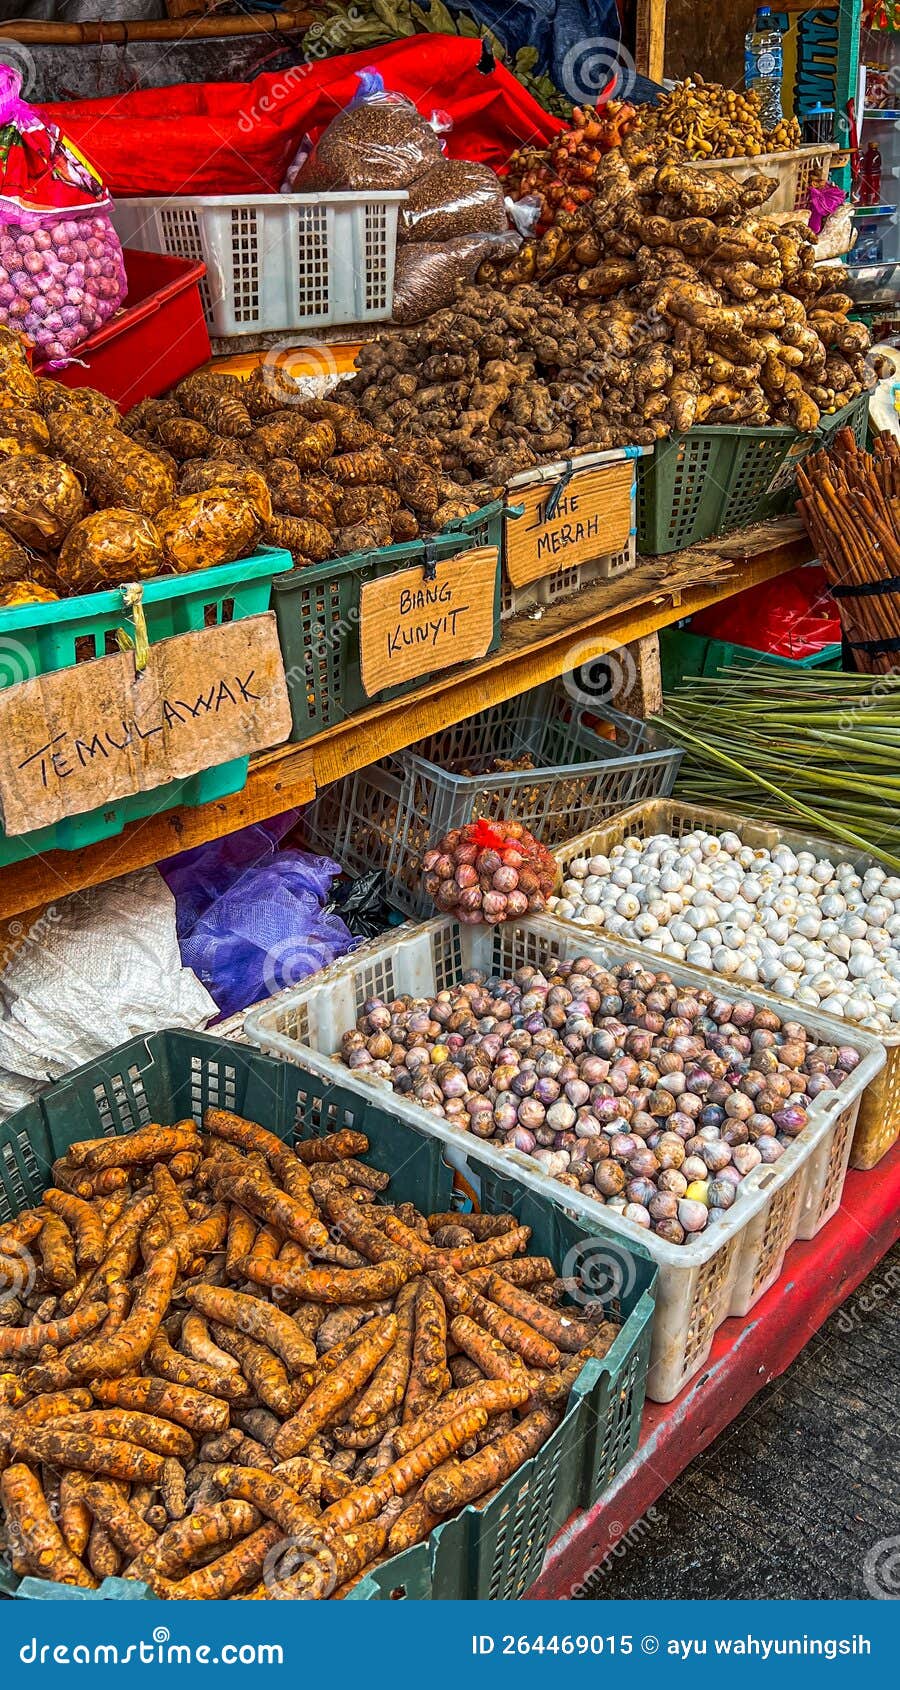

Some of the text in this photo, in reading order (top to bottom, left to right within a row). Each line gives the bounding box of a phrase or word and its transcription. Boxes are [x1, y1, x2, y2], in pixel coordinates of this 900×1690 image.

[537, 514, 599, 559] MERAH
[400, 582, 452, 615] BIANG
[387, 606, 470, 658] KUNYIT
[18, 670, 261, 786] TEMULAWAK
